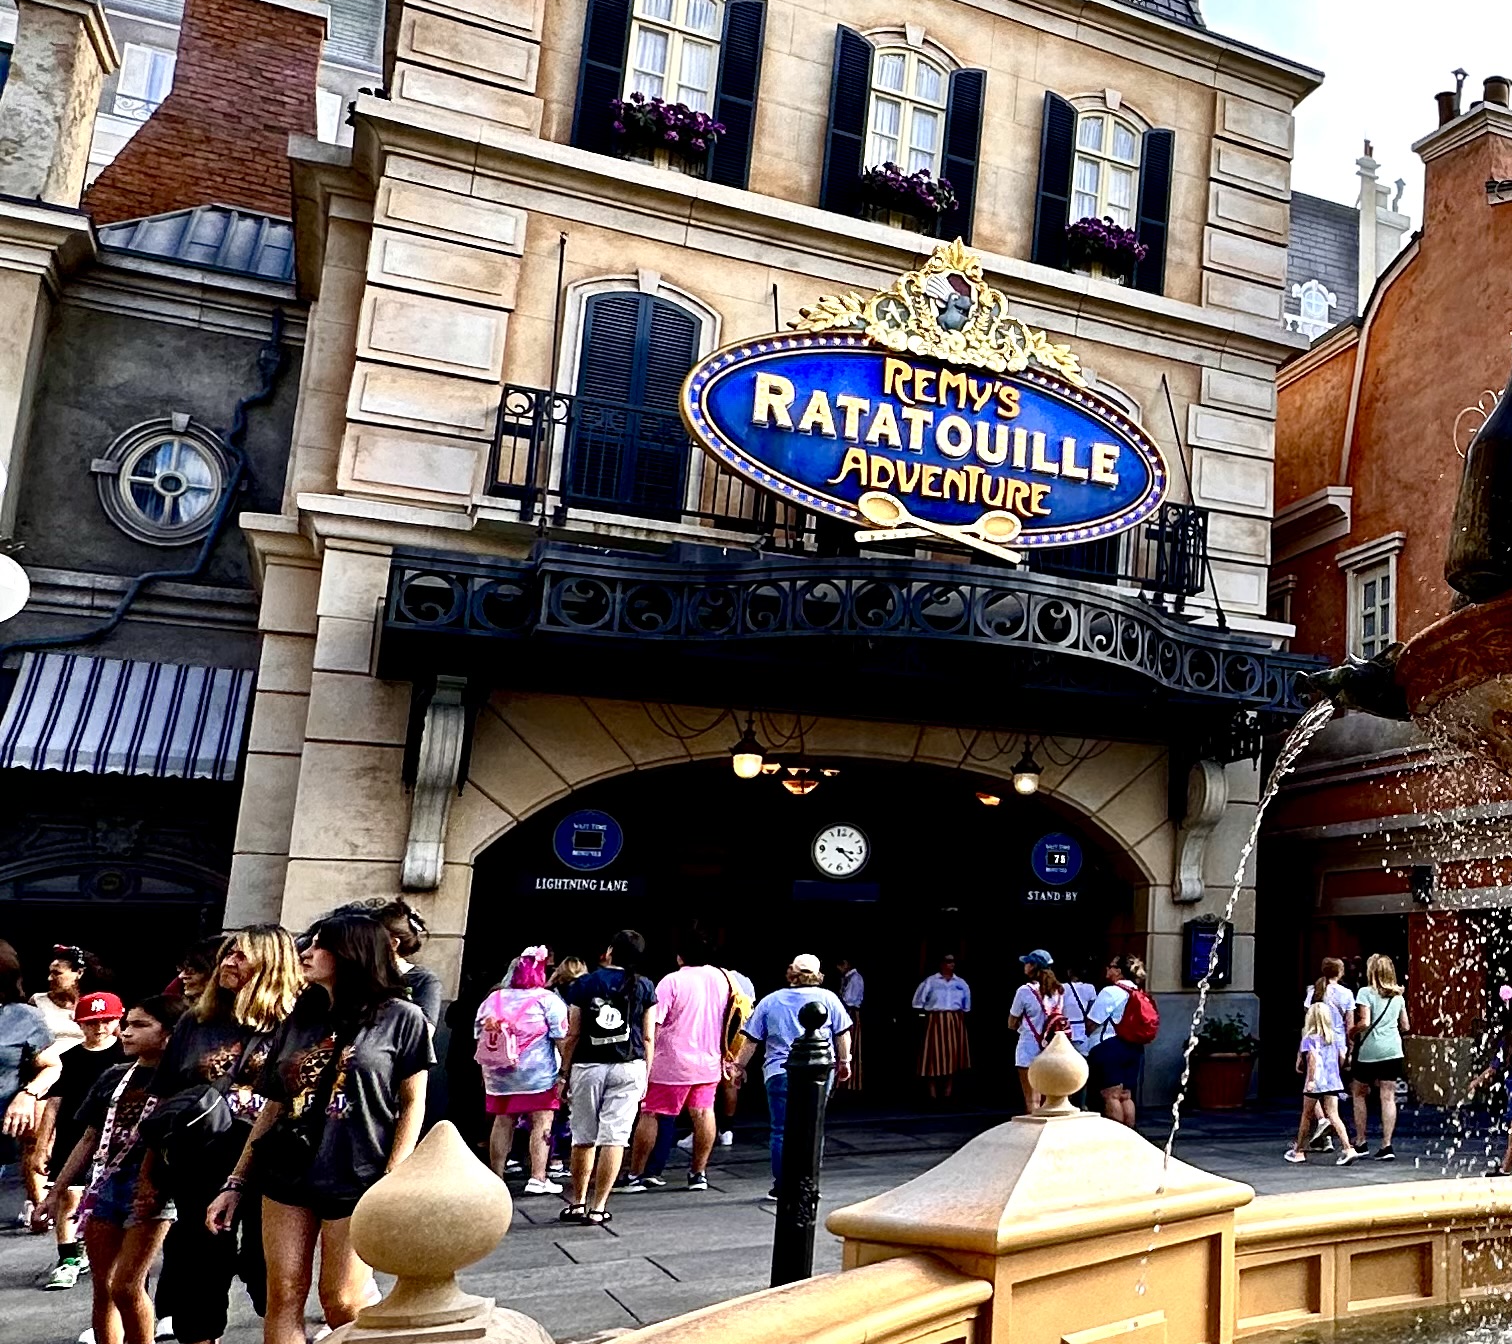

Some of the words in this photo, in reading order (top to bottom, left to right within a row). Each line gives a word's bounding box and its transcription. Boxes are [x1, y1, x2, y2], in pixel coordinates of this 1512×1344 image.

[883, 356, 1022, 420] REMY'S
[751, 371, 1121, 491] RATATOUILLE
[828, 447, 1052, 518] ADVENTURE
[535, 877, 597, 891] LIGHTNING
[599, 879, 629, 892] LANE
